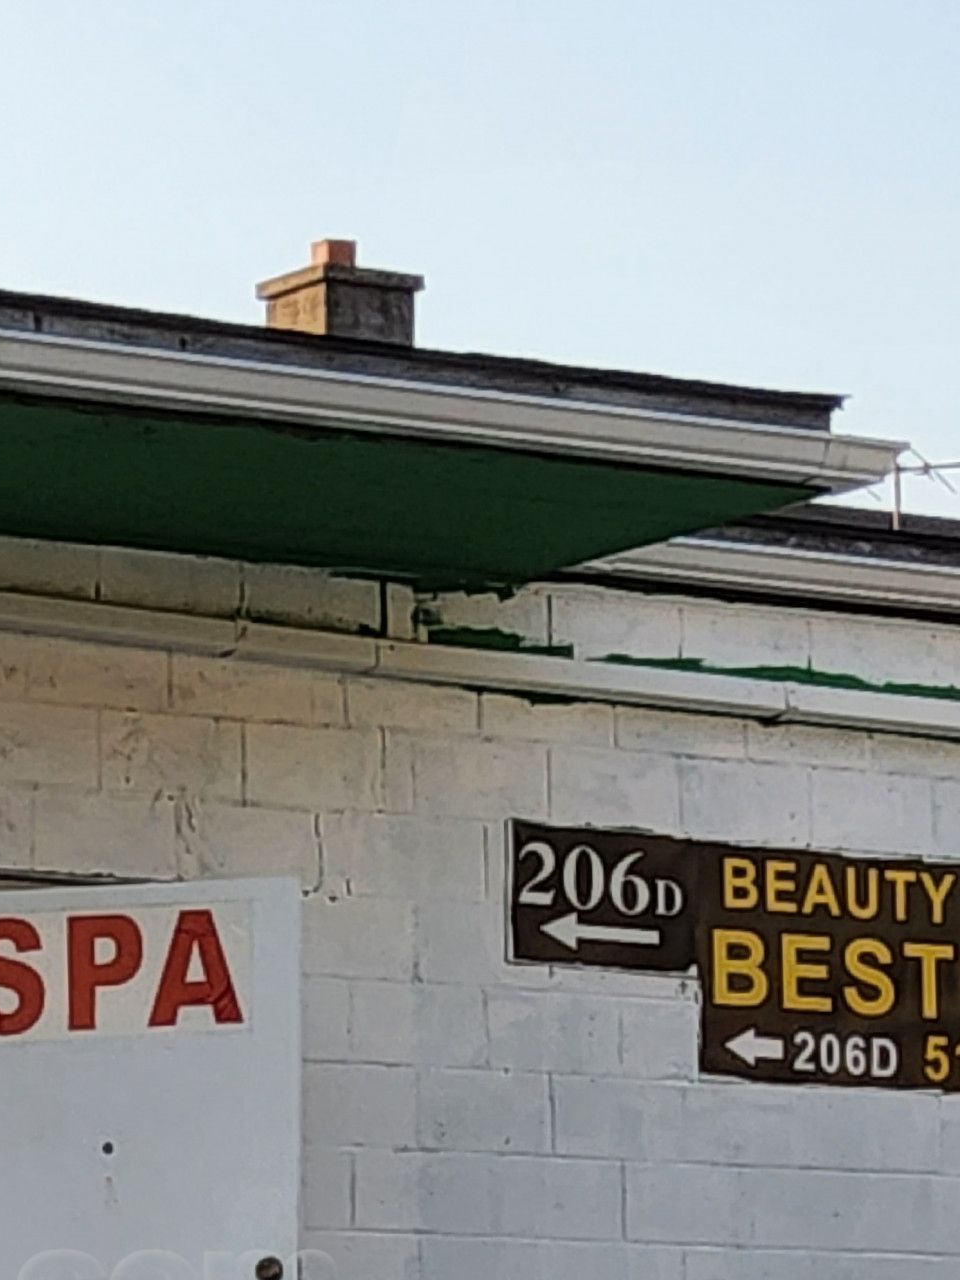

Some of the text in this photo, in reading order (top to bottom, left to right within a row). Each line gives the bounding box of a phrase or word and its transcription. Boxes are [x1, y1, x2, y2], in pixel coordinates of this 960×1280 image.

[518, 842, 683, 916] 206D
[724, 857, 954, 924] BEAUTY
[712, 928, 955, 1020] BEST
[793, 1031, 960, 1083] 206D 5
